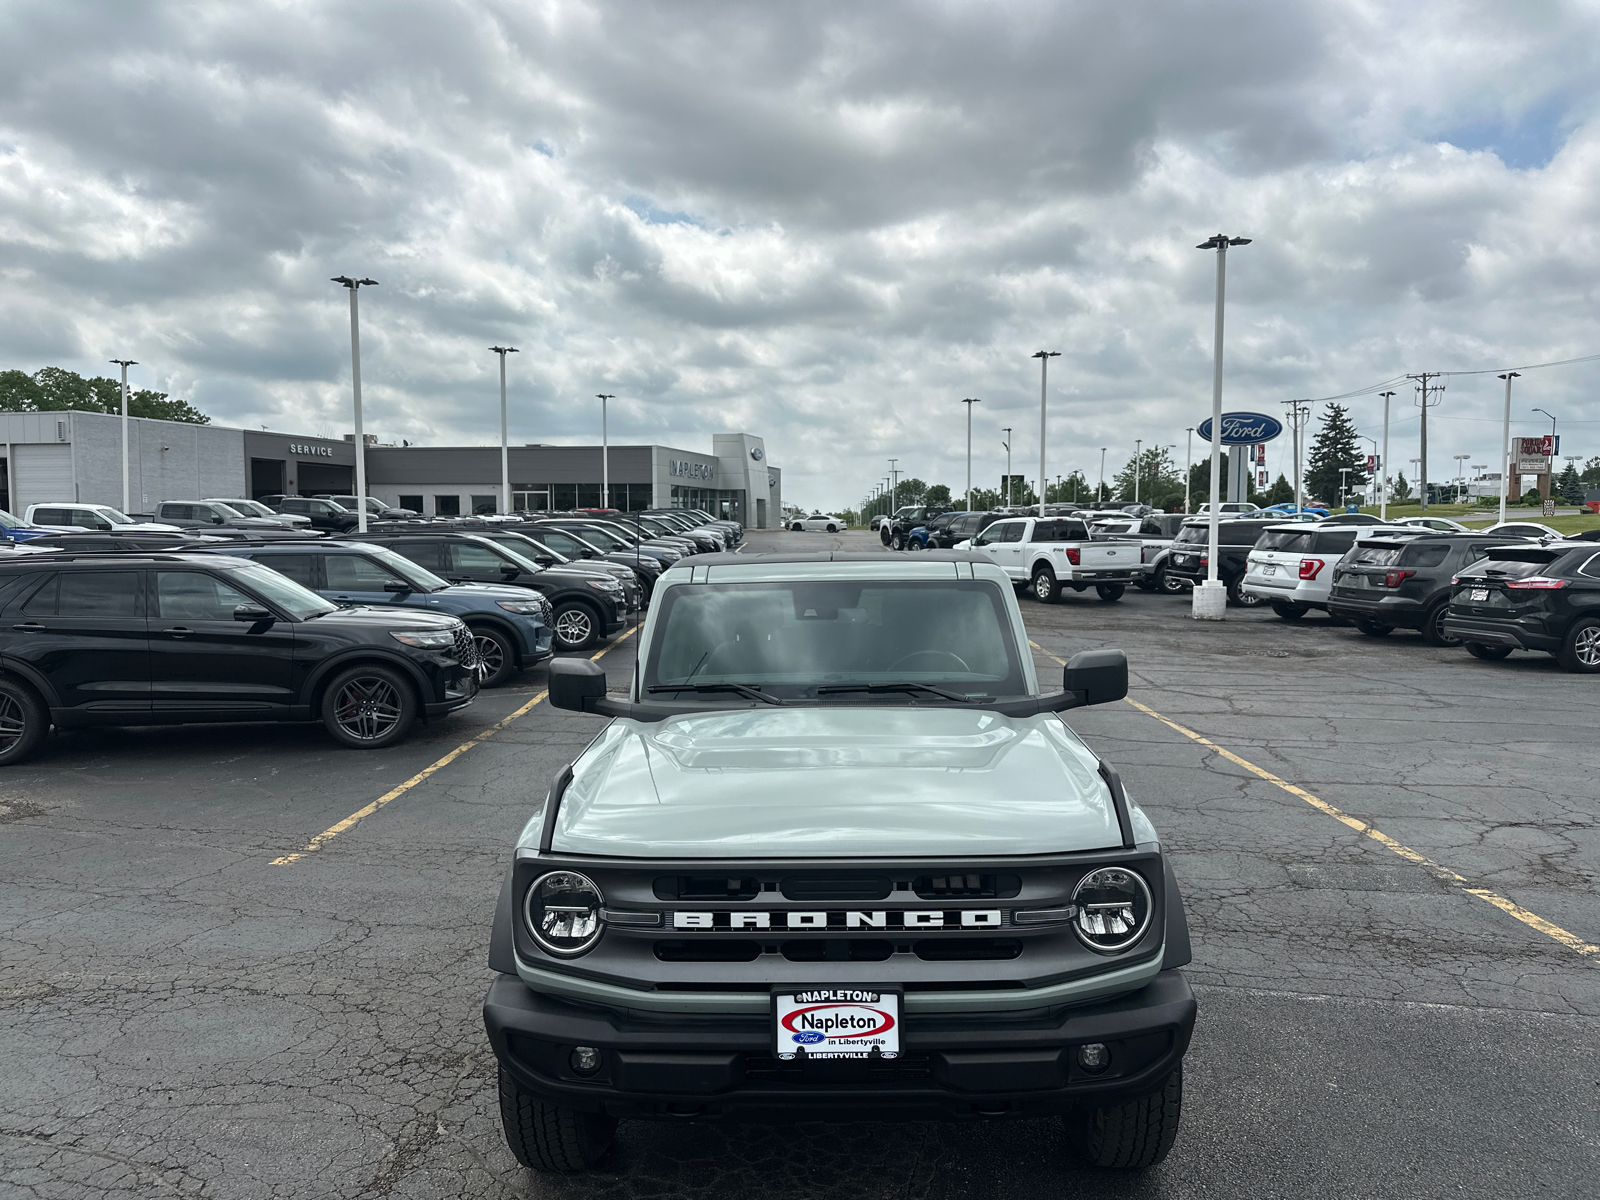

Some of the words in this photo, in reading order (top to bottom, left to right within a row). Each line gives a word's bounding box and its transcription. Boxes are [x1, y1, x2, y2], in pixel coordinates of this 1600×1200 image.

[1220, 418, 1266, 438] Ford
[290, 443, 333, 457] SERVICE
[1520, 446, 1543, 455] SQUAR
[670, 459, 714, 480] NAPLETON
[673, 910, 1002, 928] BRONCO
[802, 990, 873, 1003] NAPLETON
[801, 1013, 877, 1033] Napleton
[798, 1033, 819, 1043] Ford
[838, 1038, 886, 1047] Libertyville
